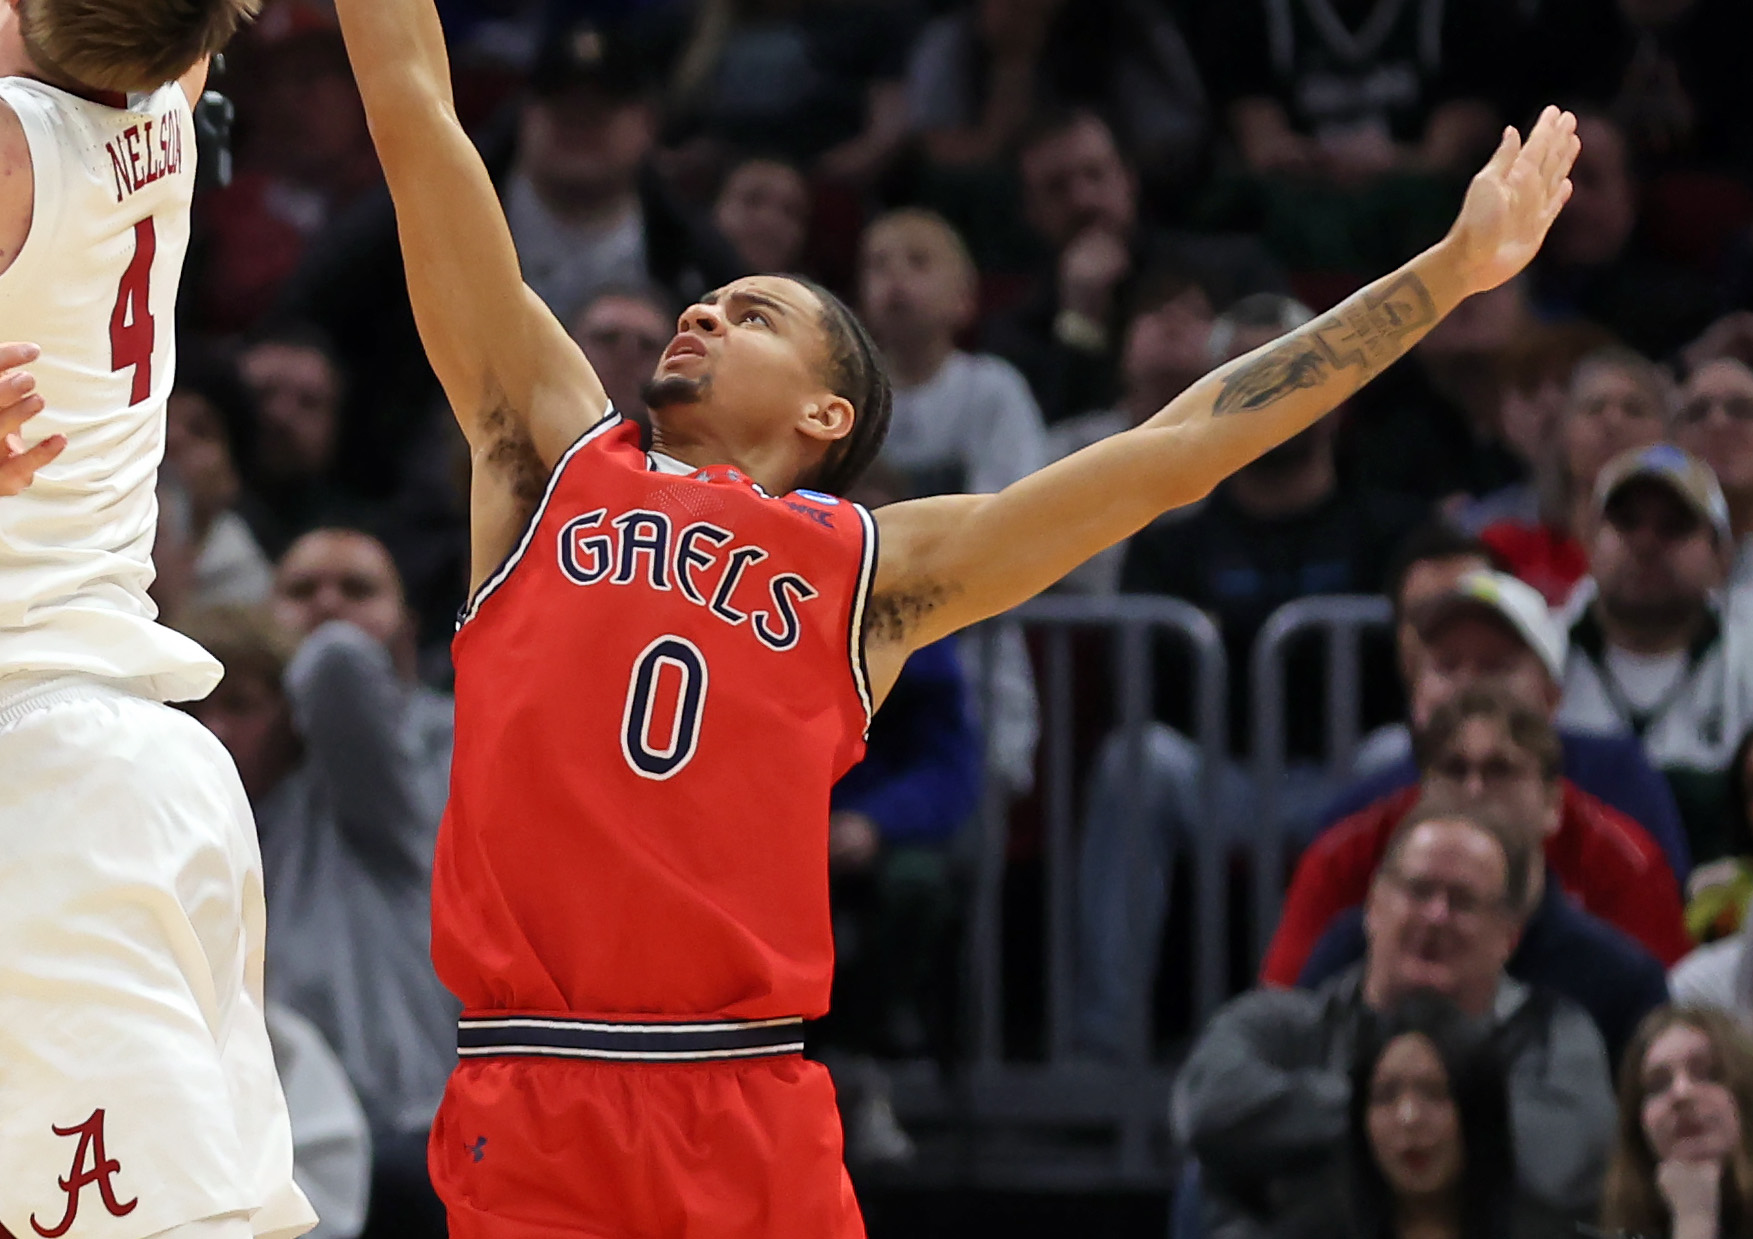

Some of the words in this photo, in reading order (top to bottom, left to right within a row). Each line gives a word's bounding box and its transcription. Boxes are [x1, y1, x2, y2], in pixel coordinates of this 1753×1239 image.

[105, 108, 182, 203] NELSON
[109, 214, 156, 408] 4
[557, 507, 820, 652] GAELS
[620, 633, 709, 781] 0
[29, 1107, 139, 1239] A
